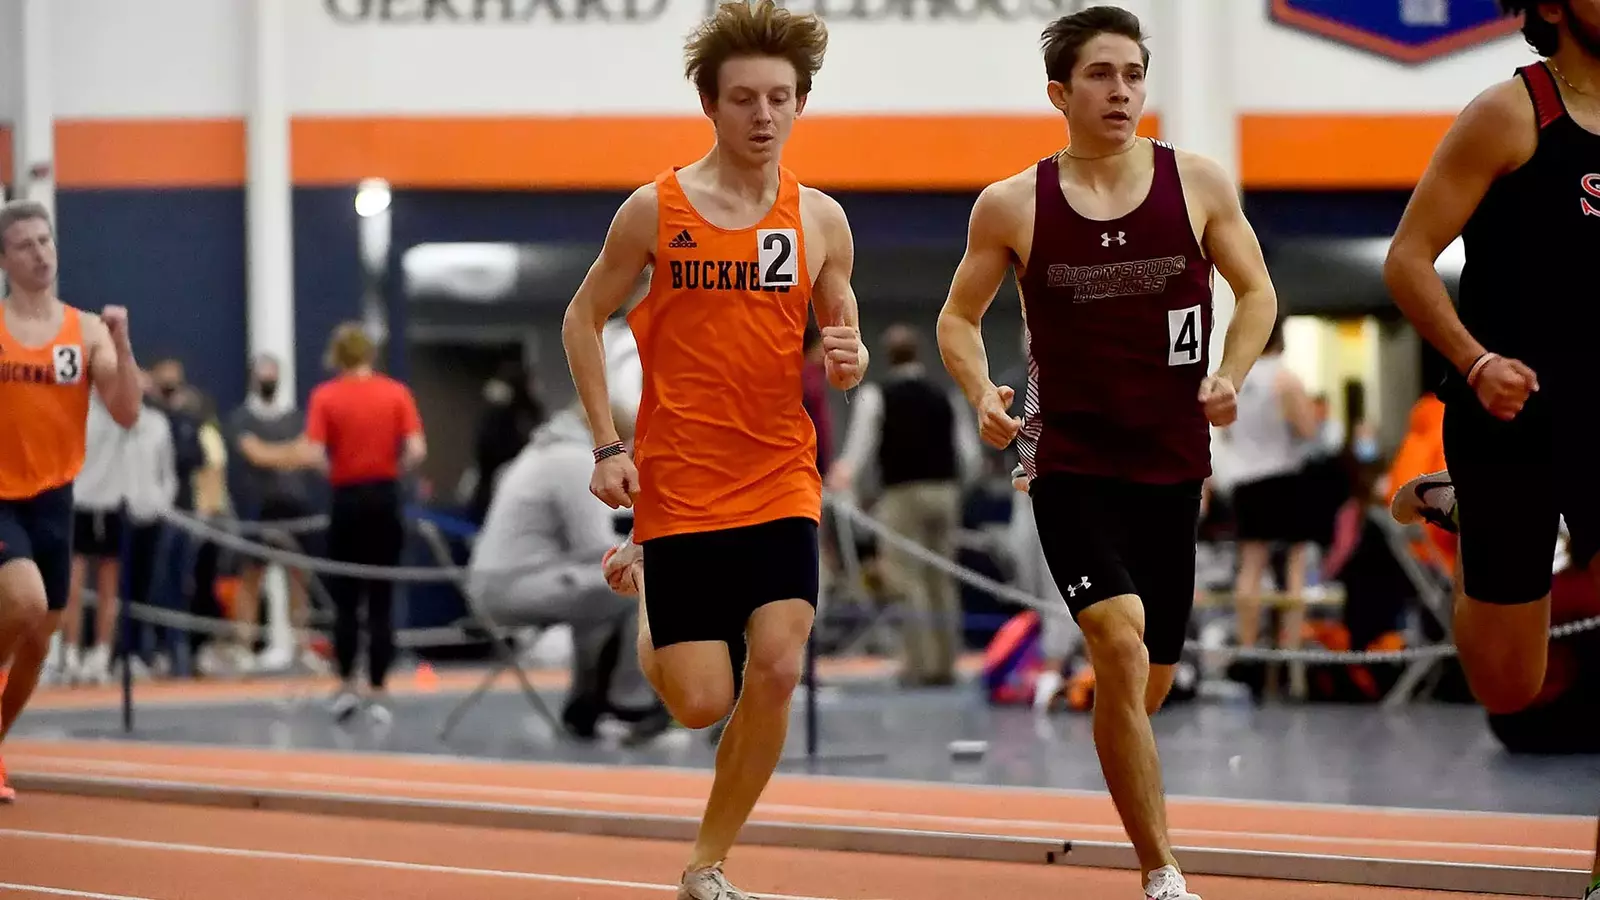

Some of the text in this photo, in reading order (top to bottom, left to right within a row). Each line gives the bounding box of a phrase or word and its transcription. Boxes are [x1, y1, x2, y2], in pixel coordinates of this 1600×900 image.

[763, 233, 792, 284] 2
[1048, 256, 1186, 287] BLOOMSBURG
[670, 260, 790, 292] BUCKNE
[1073, 275, 1167, 304] HUSKIES
[1173, 310, 1199, 361] 4
[58, 348, 78, 378] 3
